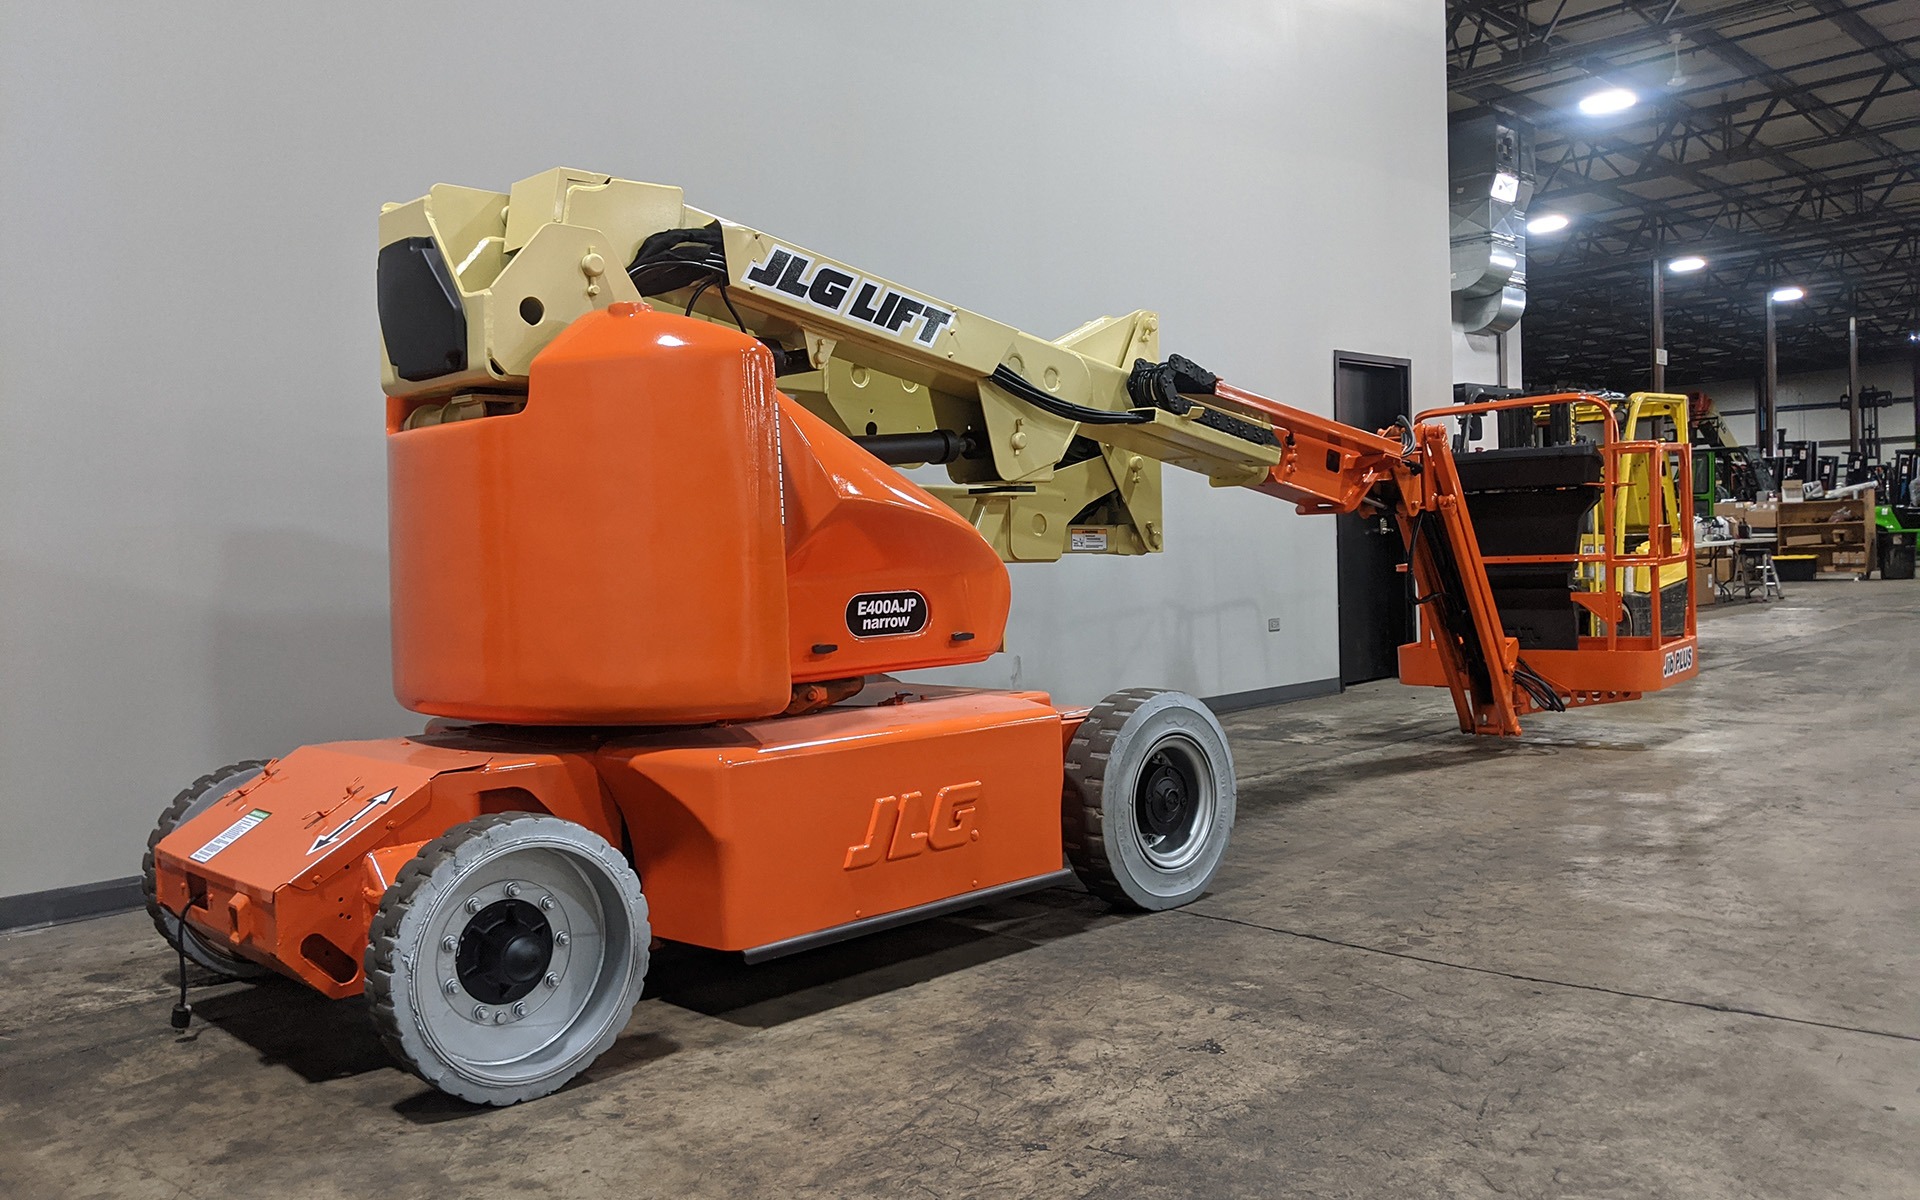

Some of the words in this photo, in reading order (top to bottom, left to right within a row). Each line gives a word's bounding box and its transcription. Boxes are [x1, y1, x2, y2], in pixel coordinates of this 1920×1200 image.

[747, 249, 855, 311] JLG
[848, 282, 951, 344] LIFT
[857, 598, 917, 616] E400AJP
[862, 615, 910, 630] narrow
[1674, 645, 1693, 674] PLUS
[843, 780, 982, 872] JLG
